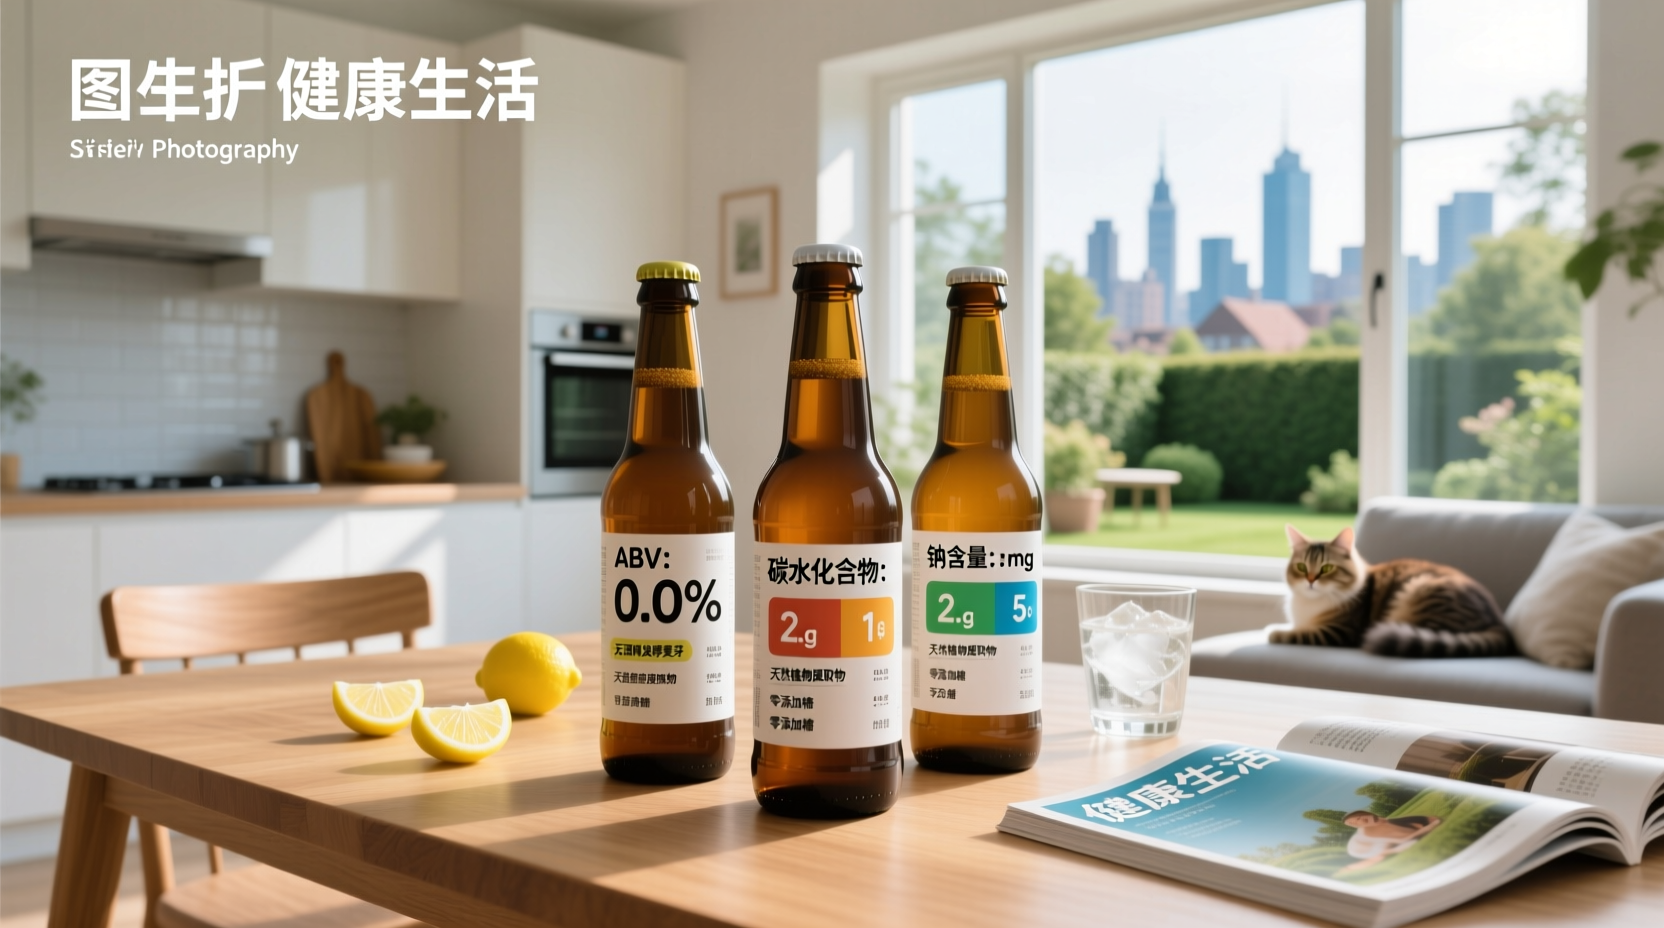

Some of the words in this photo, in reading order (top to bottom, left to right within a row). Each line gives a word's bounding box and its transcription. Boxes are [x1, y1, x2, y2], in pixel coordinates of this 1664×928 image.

[614, 546, 670, 570] ABV:
[767, 556, 886, 586] 碳水化合物:
[614, 578, 722, 624] 0.0%
